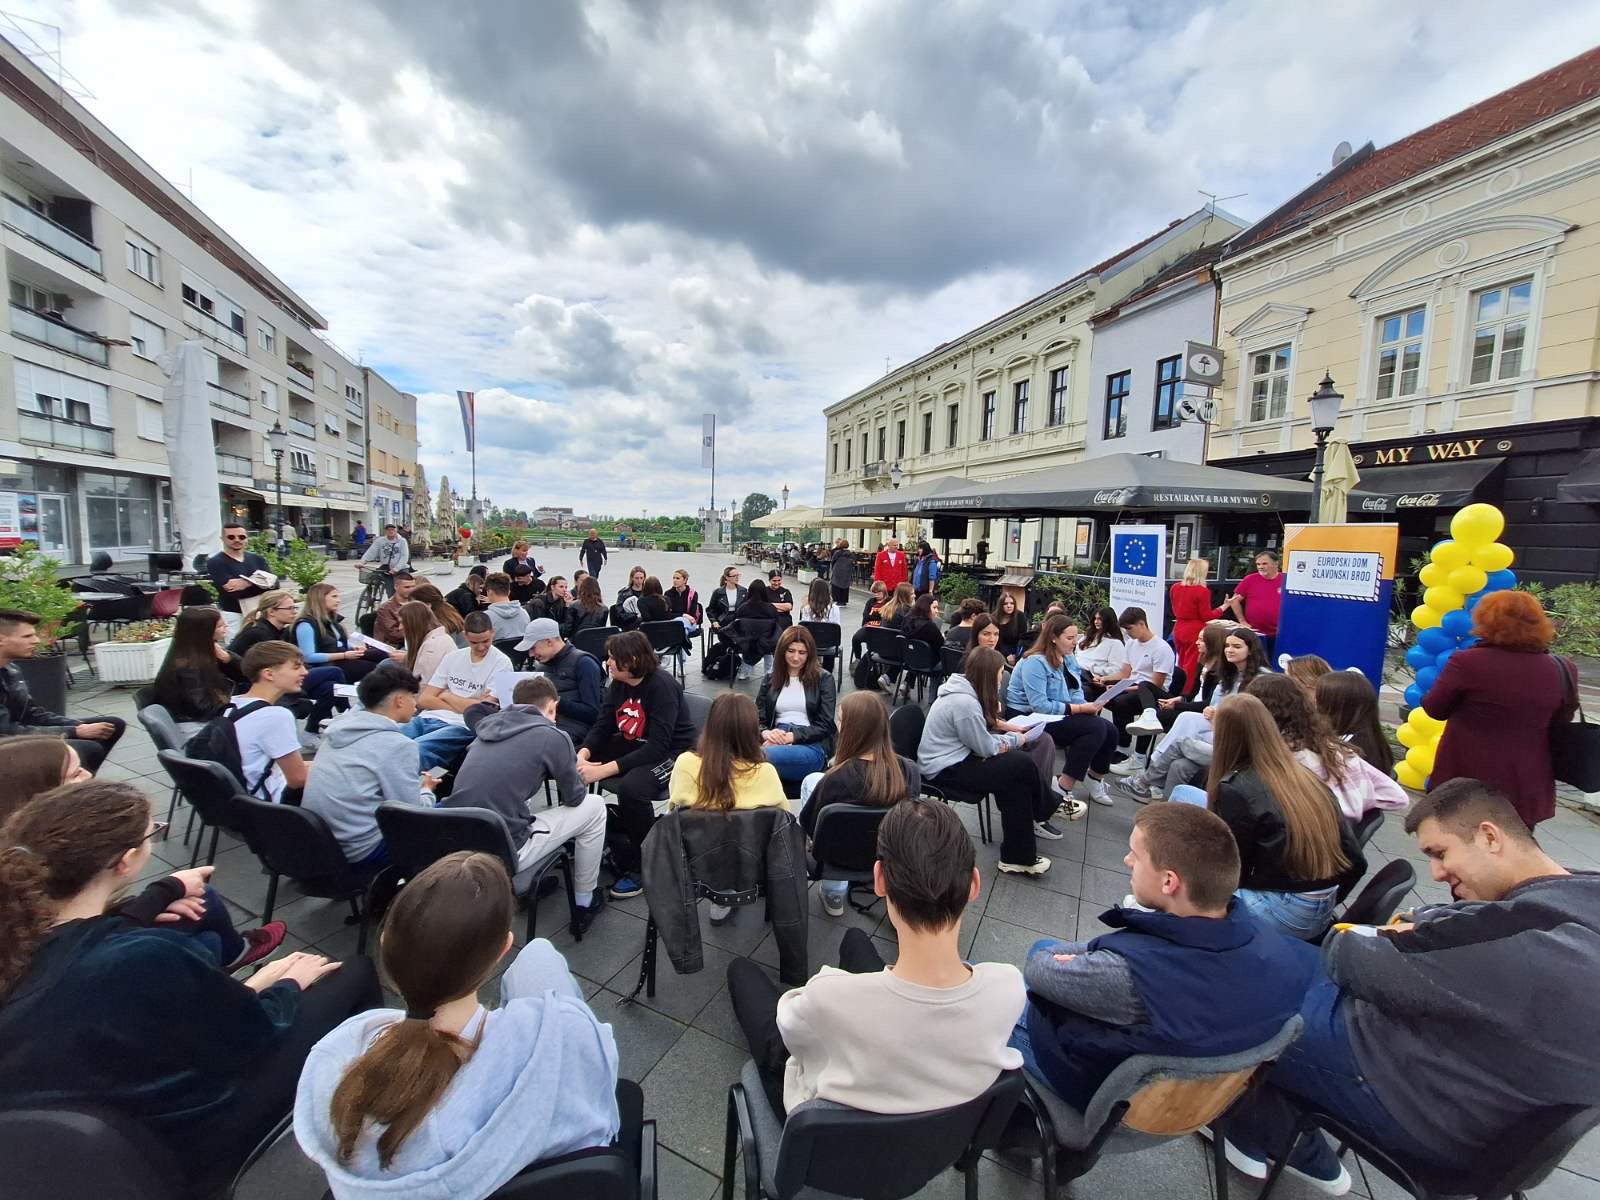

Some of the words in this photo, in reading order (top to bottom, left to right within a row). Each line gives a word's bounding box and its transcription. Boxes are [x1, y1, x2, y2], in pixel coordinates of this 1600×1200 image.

[1375, 446, 1414, 465] MY
[1427, 439, 1484, 460] WAY
[1153, 493, 1203, 503] RESTAURANT
[1205, 495, 1212, 503] &
[1213, 495, 1229, 504] BAR
[1229, 495, 1243, 504] MY
[1243, 496, 1258, 505] WAY
[1317, 556, 1350, 567] EUROPSKI
[1352, 557, 1368, 568] DOM
[1312, 568, 1349, 580] SLAVONSKI
[1351, 571, 1371, 582] BROD
[1112, 576, 1135, 586] EUROPE
[1135, 579, 1157, 589] DIRECT
